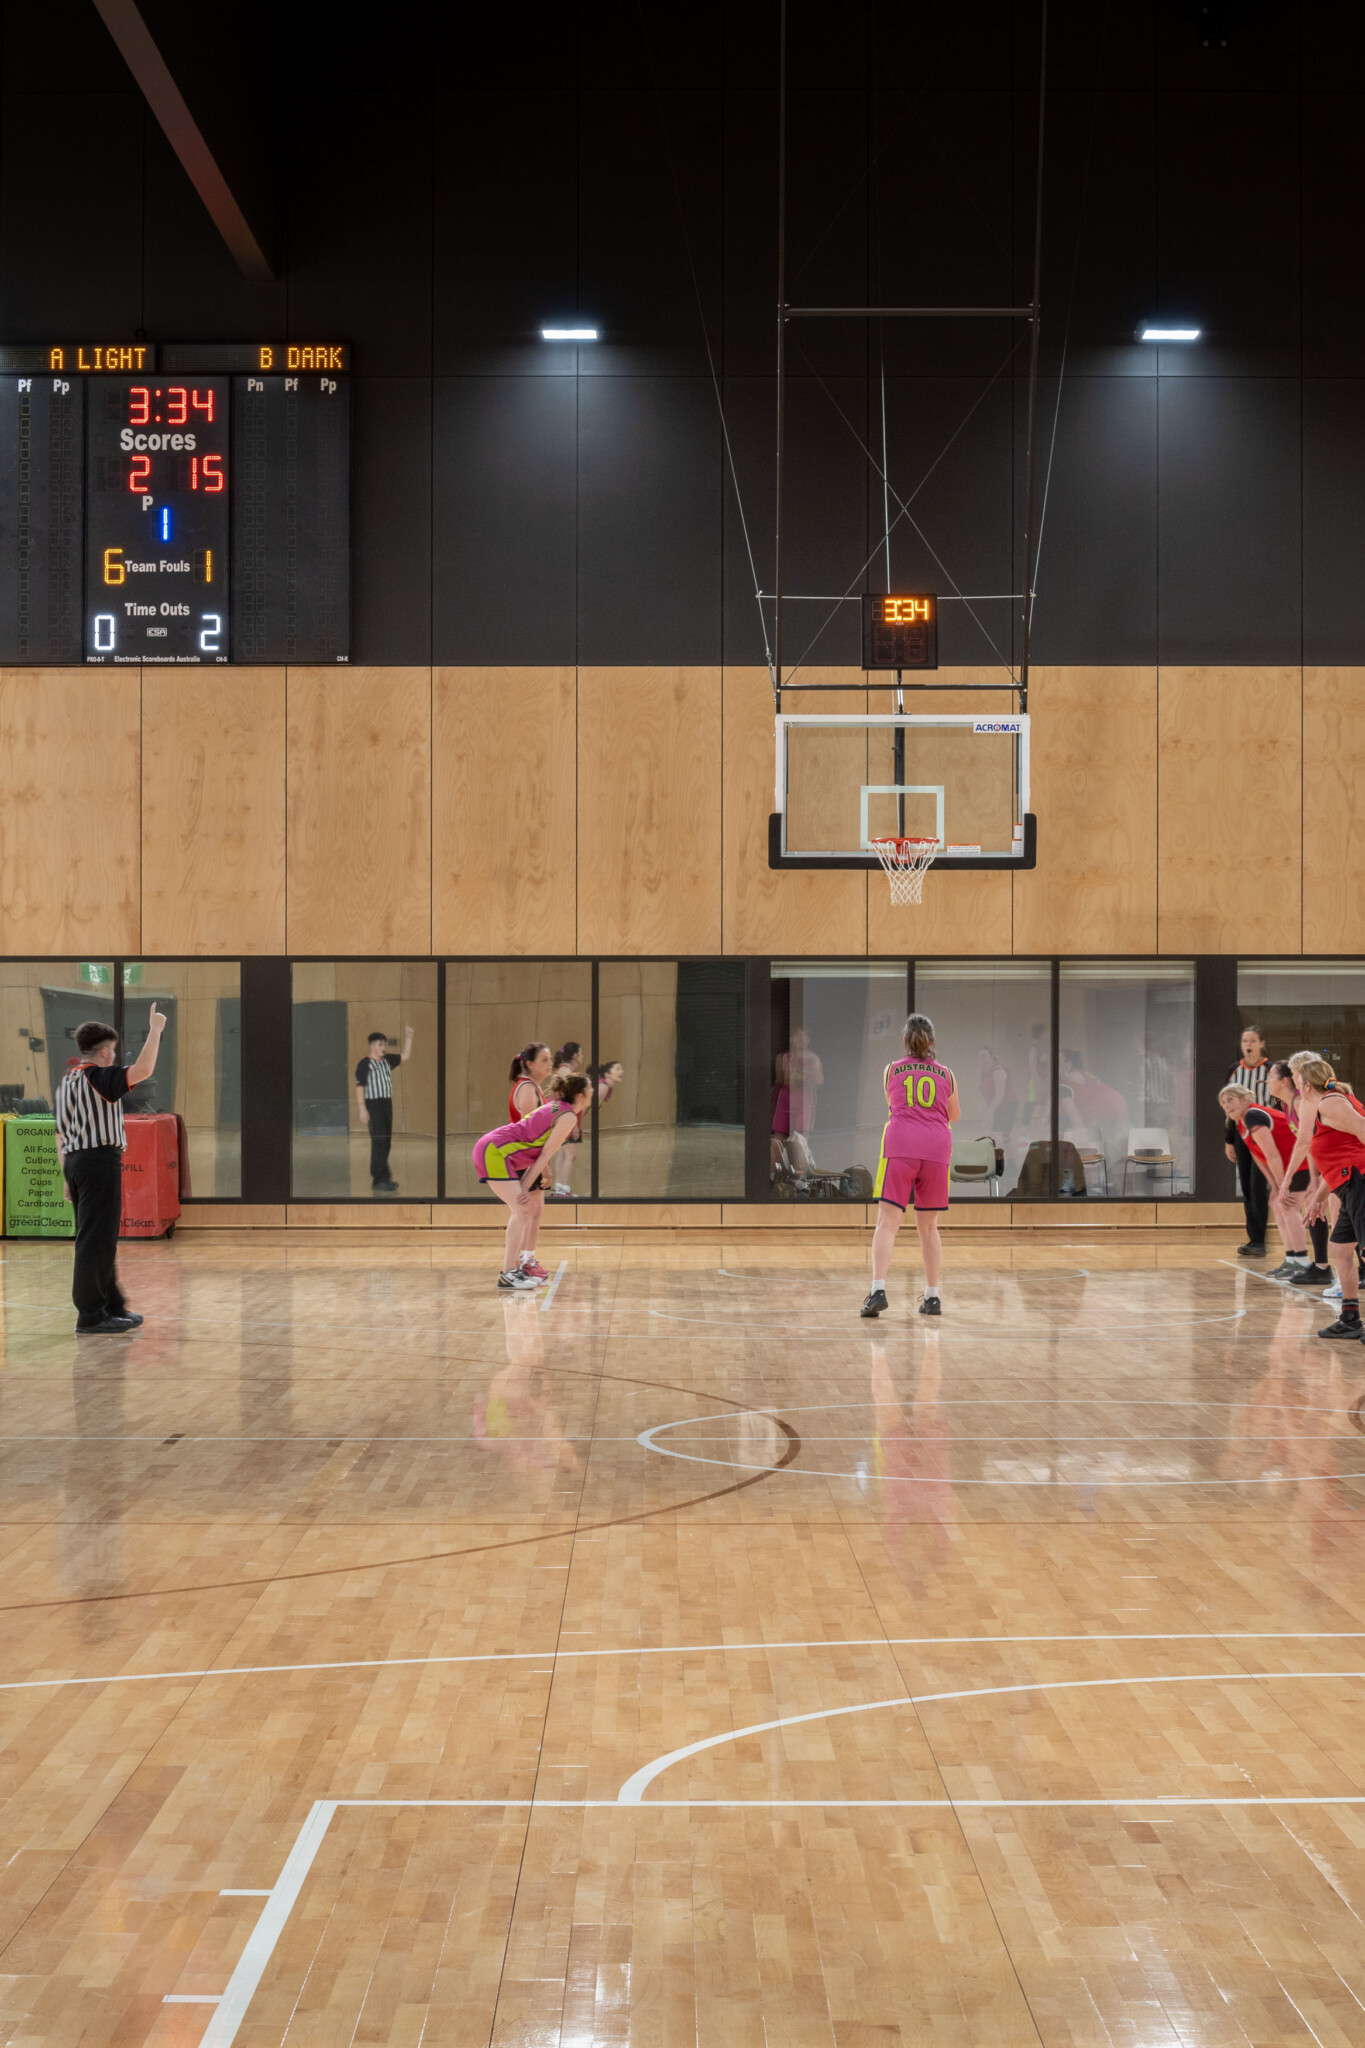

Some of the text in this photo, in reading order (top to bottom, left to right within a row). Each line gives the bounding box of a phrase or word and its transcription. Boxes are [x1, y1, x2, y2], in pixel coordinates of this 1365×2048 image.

[51, 348, 146, 369] A LIGHT
[260, 347, 342, 368] B DARK
[18, 379, 70, 395] Pf Pp
[247, 378, 337, 394] Pn Pf Pp
[130, 387, 213, 424] 3:34
[120, 428, 197, 451] Scores
[129, 456, 151, 492] 2
[191, 455, 224, 492] 15
[142, 495, 154, 511] P
[103, 548, 125, 585] 6
[125, 560, 191, 573] Team Fouls
[124, 602, 190, 616] Time Outs
[885, 599, 929, 621] 3:34
[94, 614, 115, 651] 0
[200, 614, 221, 651] 2
[114, 655, 201, 663] Electronic Scoreboards Australia
[975, 723, 1021, 732] ACROMAT
[894, 1063, 947, 1081] AUSTRALIA
[903, 1074, 936, 1109] 10
[16, 1128, 57, 1136] ORGANI
[23, 1145, 35, 1153] All
[25, 1157, 57, 1166] Cutlery
[21, 1167, 61, 1177] Crockery
[30, 1178, 53, 1187] Cups
[28, 1189, 54, 1198] Paper
[17, 1200, 65, 1208] Cardboard
[9, 1217, 73, 1229] greenClean
